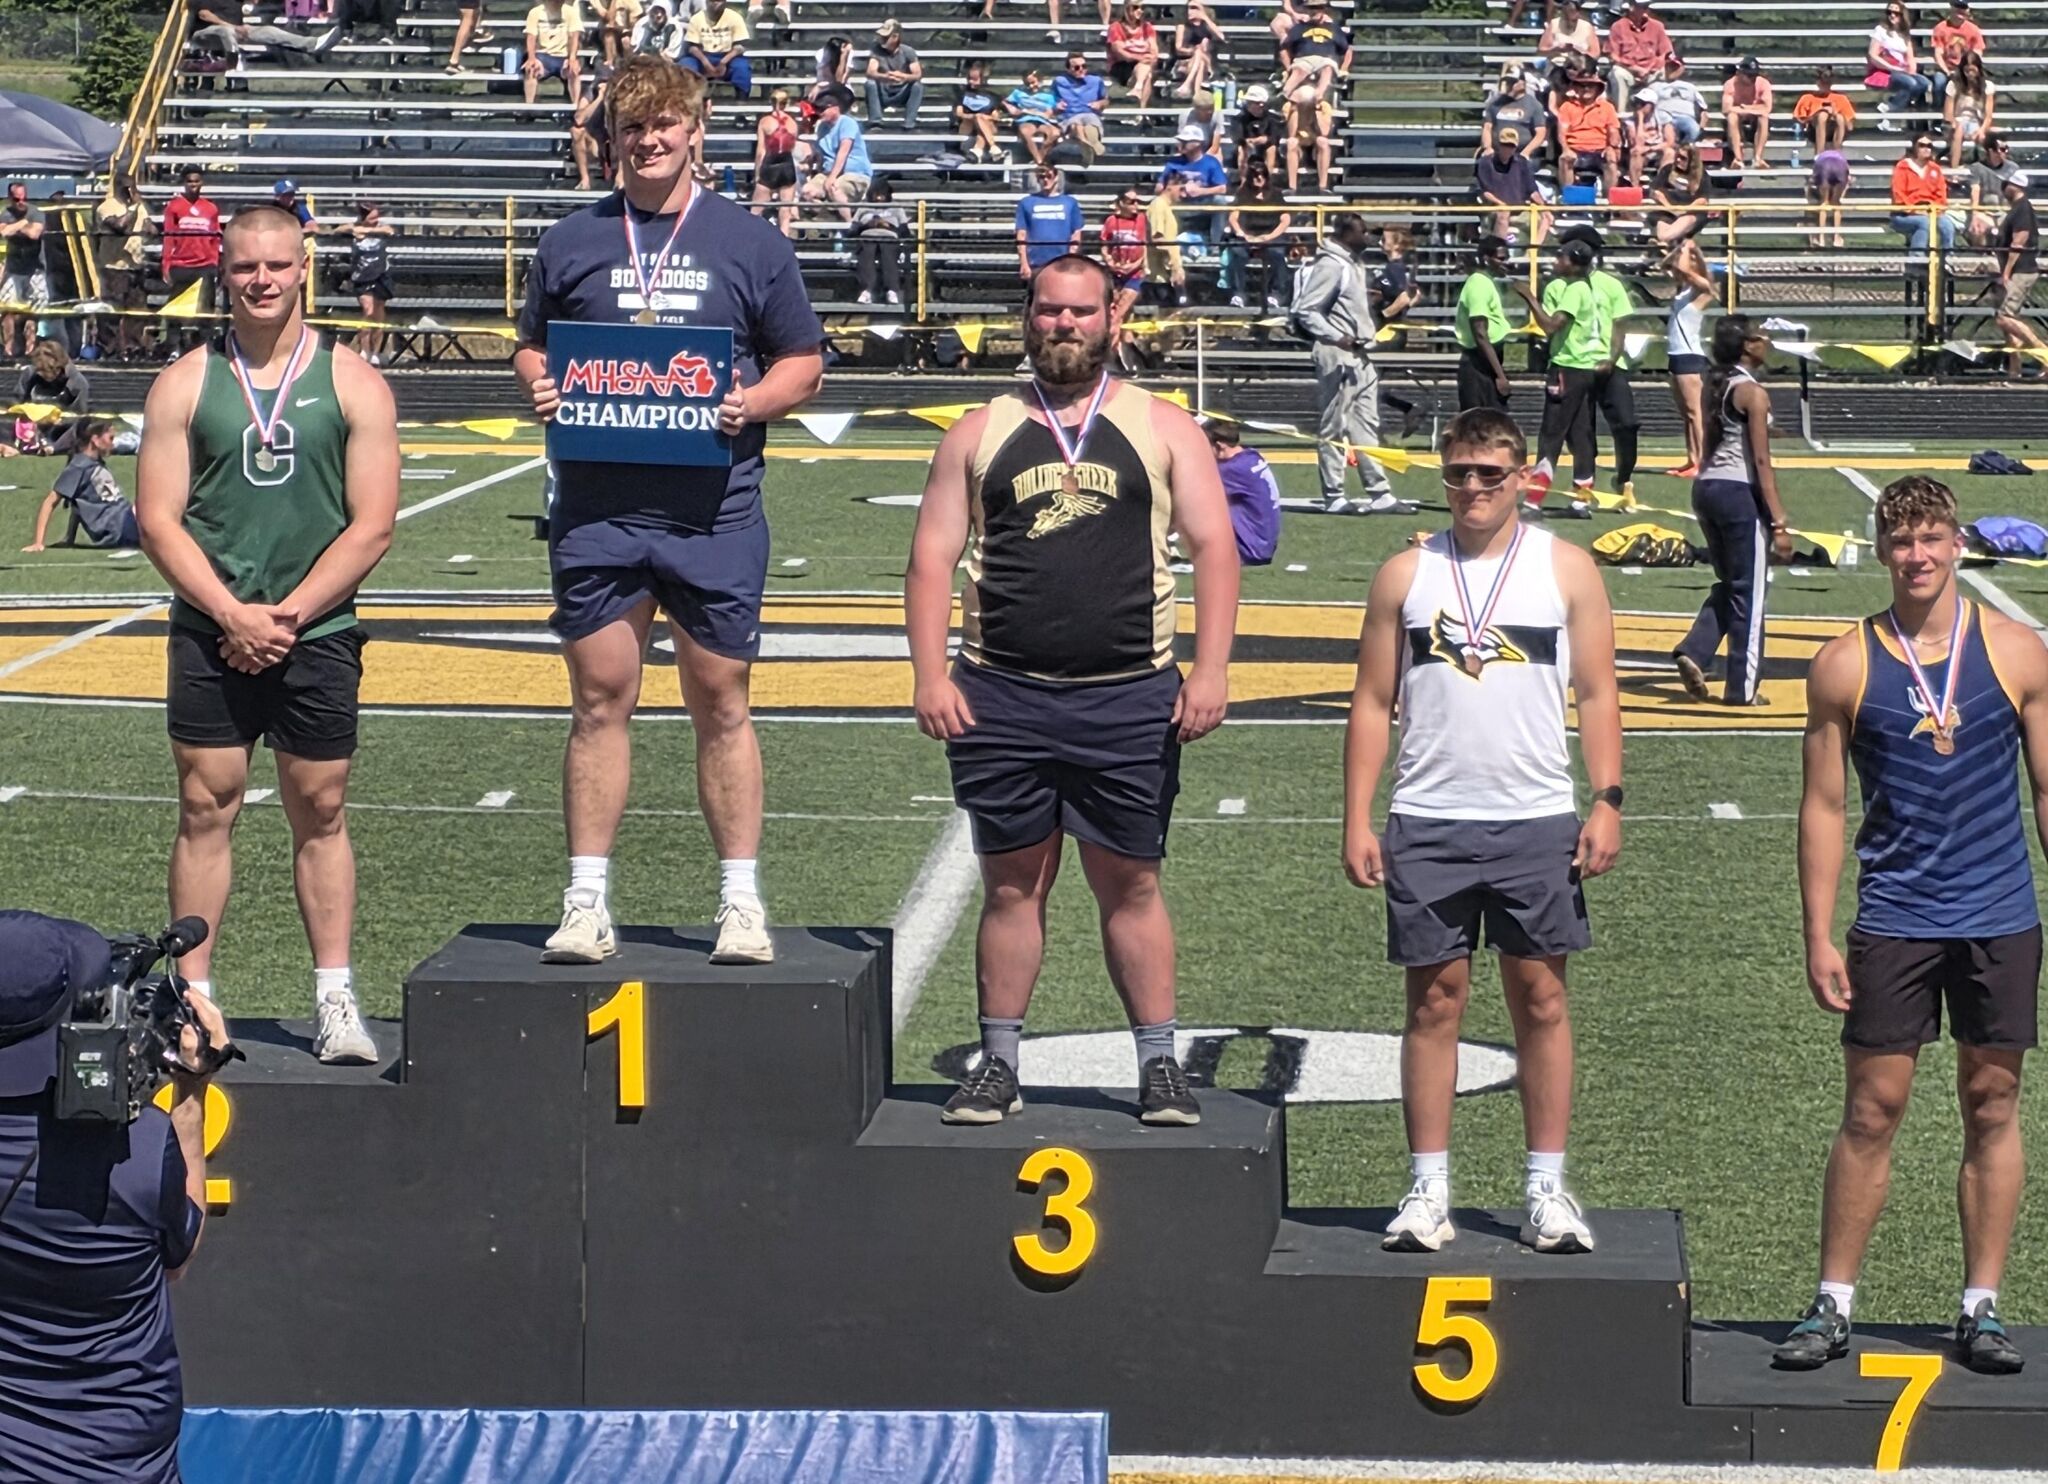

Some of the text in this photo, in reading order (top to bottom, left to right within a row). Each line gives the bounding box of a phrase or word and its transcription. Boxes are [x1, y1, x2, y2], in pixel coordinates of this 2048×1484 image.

[609, 268, 709, 291] BUDOGS
[555, 401, 720, 431] CHAMPION
[562, 357, 697, 397] MHSAA
[242, 419, 295, 487] C
[587, 981, 645, 1106] 1
[1013, 1147, 1097, 1275] 3
[1413, 1276, 1498, 1402] 5
[1859, 1353, 1943, 1473] 7
